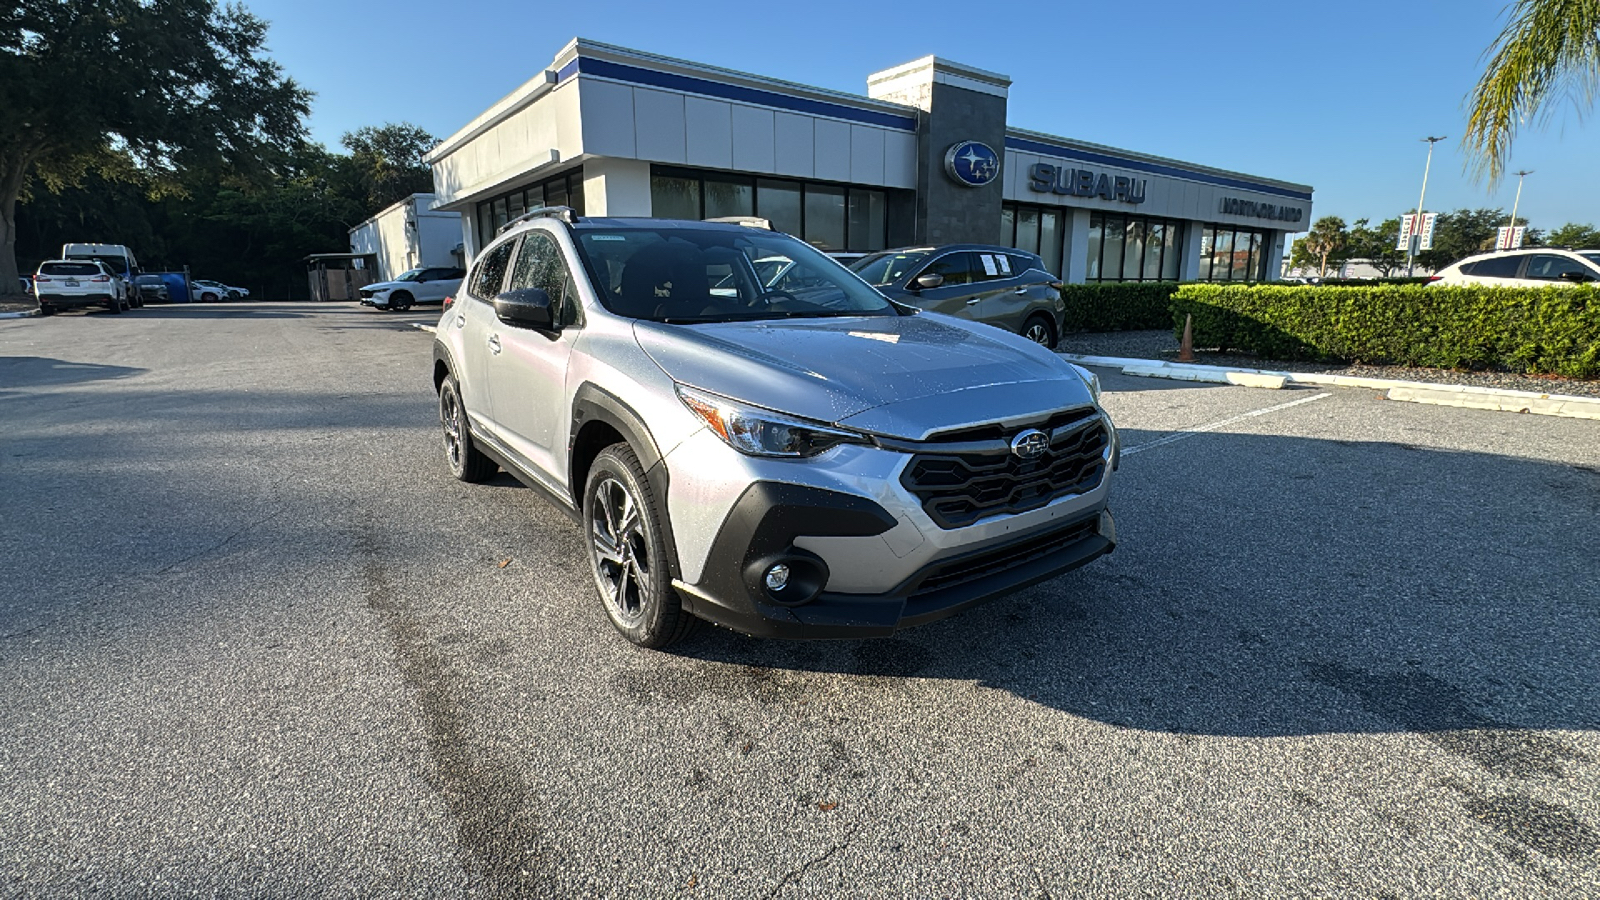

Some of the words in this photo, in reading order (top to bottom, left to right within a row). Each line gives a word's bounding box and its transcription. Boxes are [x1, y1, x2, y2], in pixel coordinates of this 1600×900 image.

[1029, 162, 1147, 204] SUBARU
[1220, 196, 1258, 217] NORTH
[1257, 203, 1302, 222] ORLANDO
